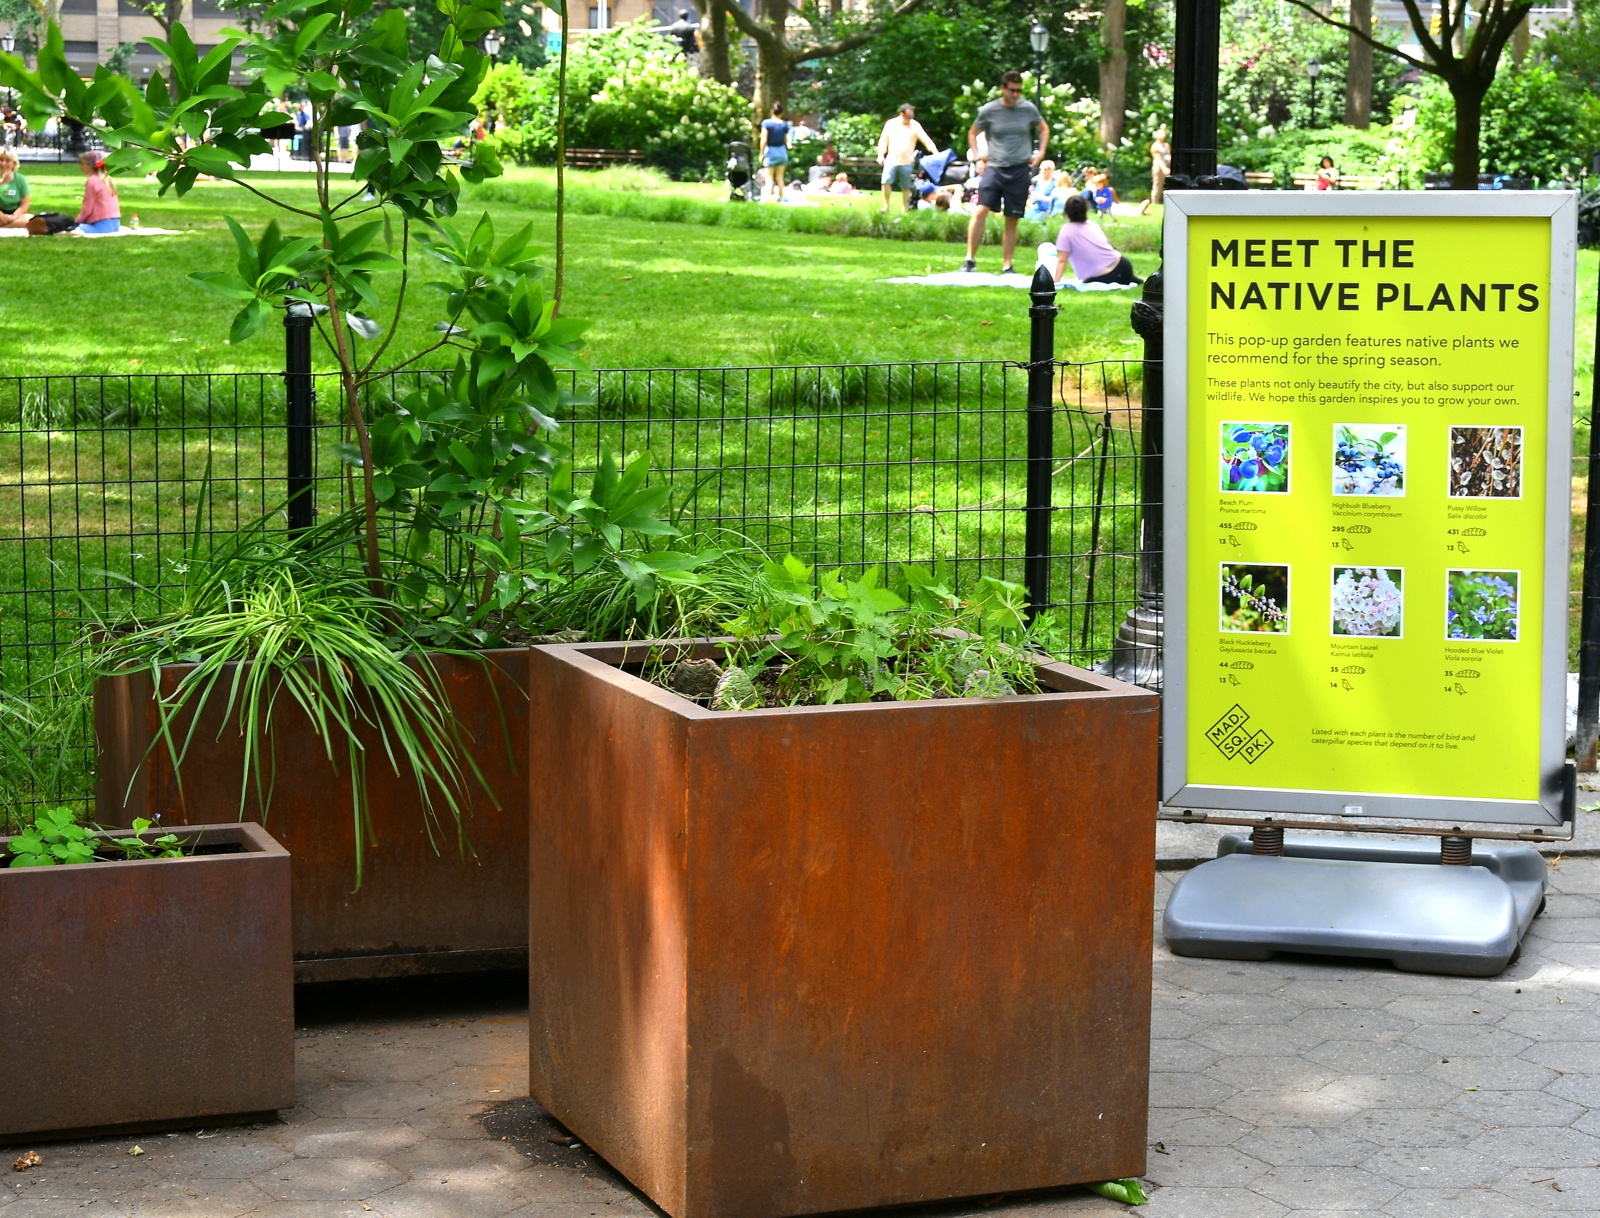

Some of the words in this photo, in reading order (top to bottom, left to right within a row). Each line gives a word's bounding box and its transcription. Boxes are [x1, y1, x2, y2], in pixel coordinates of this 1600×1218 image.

[1211, 239, 1319, 267] MEET
[1335, 240, 1414, 268] THE
[1211, 282, 1359, 310] NATIVE
[1377, 283, 1539, 312] PLANTS
[1207, 333, 1234, 345] This
[1239, 337, 1288, 349] pop-up
[1293, 334, 1341, 349] garden
[1346, 334, 1401, 347] features
[1406, 336, 1447, 347] native
[1453, 335, 1494, 351] plants
[1499, 340, 1519, 348] we
[1208, 352, 1288, 364] recommend
[1293, 352, 1312, 364] for
[1316, 352, 1338, 365] the
[1343, 354, 1385, 369] spring
[1390, 357, 1441, 366] season.
[1207, 378, 1237, 387] These
[1240, 378, 1270, 389] plants
[1294, 379, 1315, 391] only
[1319, 379, 1360, 391] beautify
[1363, 380, 1380, 389] the
[1384, 381, 1403, 392] city,
[1407, 380, 1425, 390] but
[1428, 381, 1449, 390] also
[1452, 383, 1493, 393] support
[1207, 391, 1245, 401] wildlife.
[1249, 393, 1265, 401] We
[1269, 392, 1295, 404] hope
[1298, 393, 1316, 402] this
[1319, 393, 1355, 405] garden
[1359, 394, 1398, 406] inspires
[1401, 397, 1420, 406] you
[1423, 396, 1434, 404] to
[1438, 398, 1464, 407] grow
[1467, 398, 1491, 407] your
[1236, 639, 1271, 647] Huckleberry
[1211, 713, 1243, 741] MAD.
[1224, 735, 1247, 754] SQ.
[1245, 739, 1268, 757] PK.
[1390, 740, 1417, 748] depend
